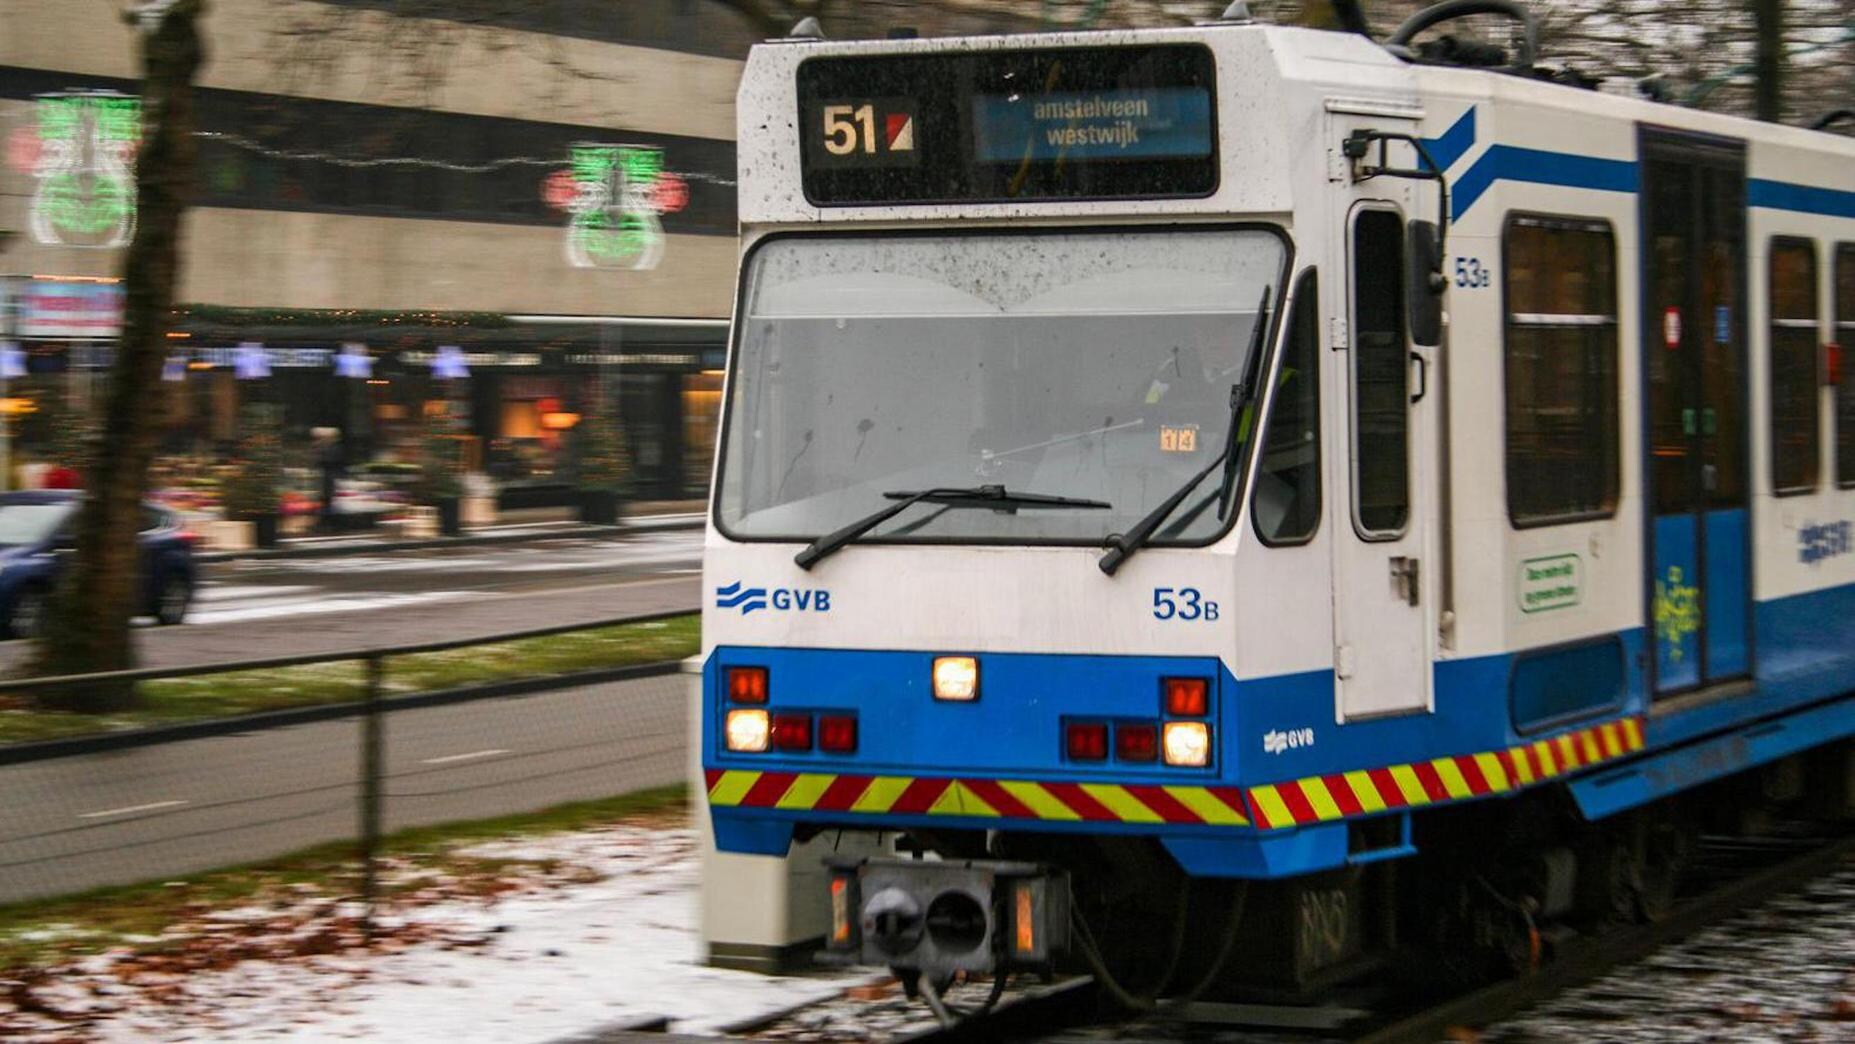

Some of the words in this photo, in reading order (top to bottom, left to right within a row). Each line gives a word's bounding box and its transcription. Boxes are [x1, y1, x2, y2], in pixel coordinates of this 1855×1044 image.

[1034, 97, 1148, 119] amstelveen
[824, 104, 876, 155] 51
[1047, 121, 1139, 148] westwijk
[772, 588, 831, 612] GVB
[1153, 587, 1219, 621] 53B
[1288, 727, 1314, 748] GVB
